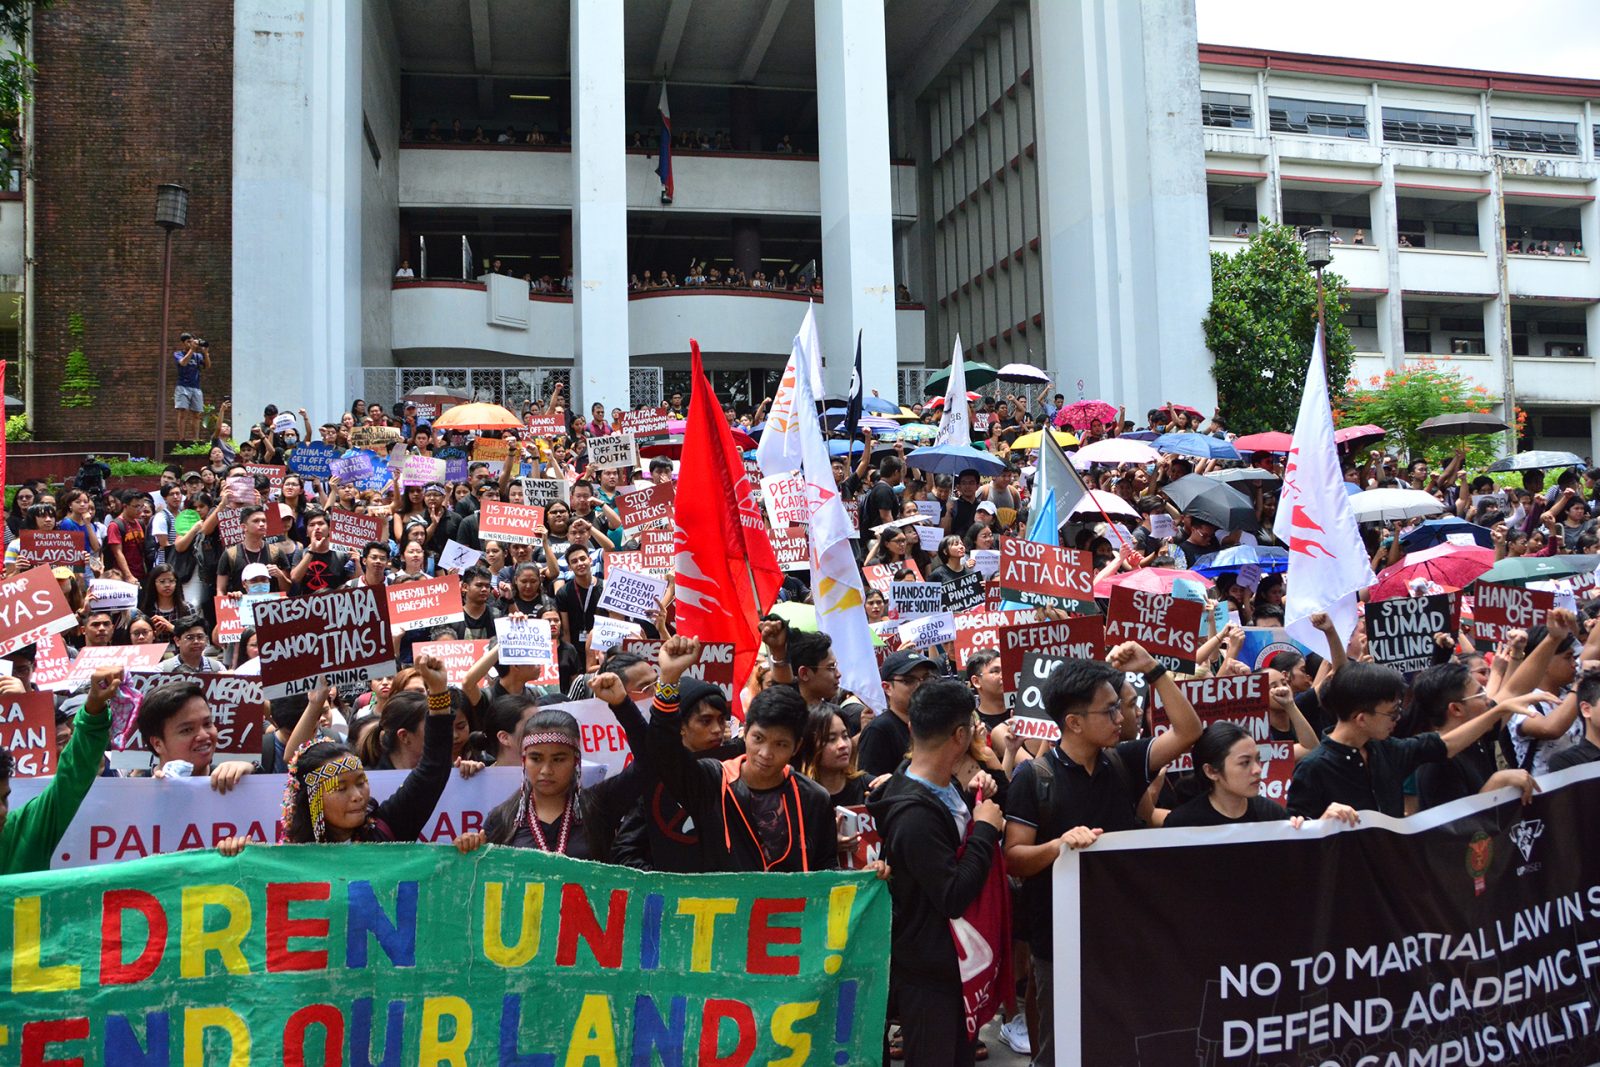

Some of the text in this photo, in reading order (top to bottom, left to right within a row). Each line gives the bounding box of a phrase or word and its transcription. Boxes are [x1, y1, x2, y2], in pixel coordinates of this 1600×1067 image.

[588, 435, 621, 448] HANDS
[593, 443, 631, 456] OFF THE
[245, 466, 281, 476] BOYCOTT
[525, 480, 559, 490] HANDS
[540, 489, 559, 498] THE
[624, 488, 654, 507] STOP
[633, 501, 650, 511] THE
[486, 504, 538, 519] US TROOPS
[624, 503, 667, 526] ATTACKS
[486, 516, 506, 526] OUT
[20, 549, 84, 561] PALAYASIN
[1004, 538, 1081, 566] STOP THE
[872, 561, 903, 577] OUST
[1005, 560, 1093, 594] ATTACKS
[619, 575, 656, 593] DEFEND
[960, 573, 978, 587] ANG
[609, 581, 660, 600] ACADEMIC
[609, 588, 654, 609] FREEDOM
[893, 585, 941, 599] HANDS OFF
[948, 586, 975, 602] PINAS
[1478, 585, 1533, 611] HANDS
[320, 588, 381, 630] IBABA
[609, 599, 627, 610] UPD
[896, 600, 940, 614] THE YOUTH
[1020, 591, 1080, 612] STAND UP
[1132, 590, 1174, 611] STOP
[1381, 596, 1429, 617] STOP
[1138, 608, 1167, 627] THE
[1373, 610, 1445, 638] LUMAD
[1506, 604, 1546, 626] OFF
[506, 632, 545, 643] CAMPUS
[528, 626, 540, 635] TO
[600, 628, 616, 638] OFF
[919, 629, 940, 641] OUR
[1006, 623, 1070, 650] DEFEND
[1106, 620, 1195, 654] ATTACKS
[1475, 621, 1497, 639] THE
[508, 648, 526, 657] UPD
[699, 643, 734, 664] ANG
[1368, 634, 1435, 662] KILLING
[206, 677, 265, 705] NEGROS
[285, 675, 319, 697] ALAY
[325, 667, 369, 687] SINING
[1219, 961, 1282, 999] NO
[1290, 951, 1336, 991] TO
[1345, 926, 1496, 981] MARTIAL
[1495, 900, 1551, 952] LAW
[1556, 890, 1585, 928] IN
[1222, 996, 1394, 1058] DEFEND
[1401, 948, 1578, 1029] ACADEMIC
